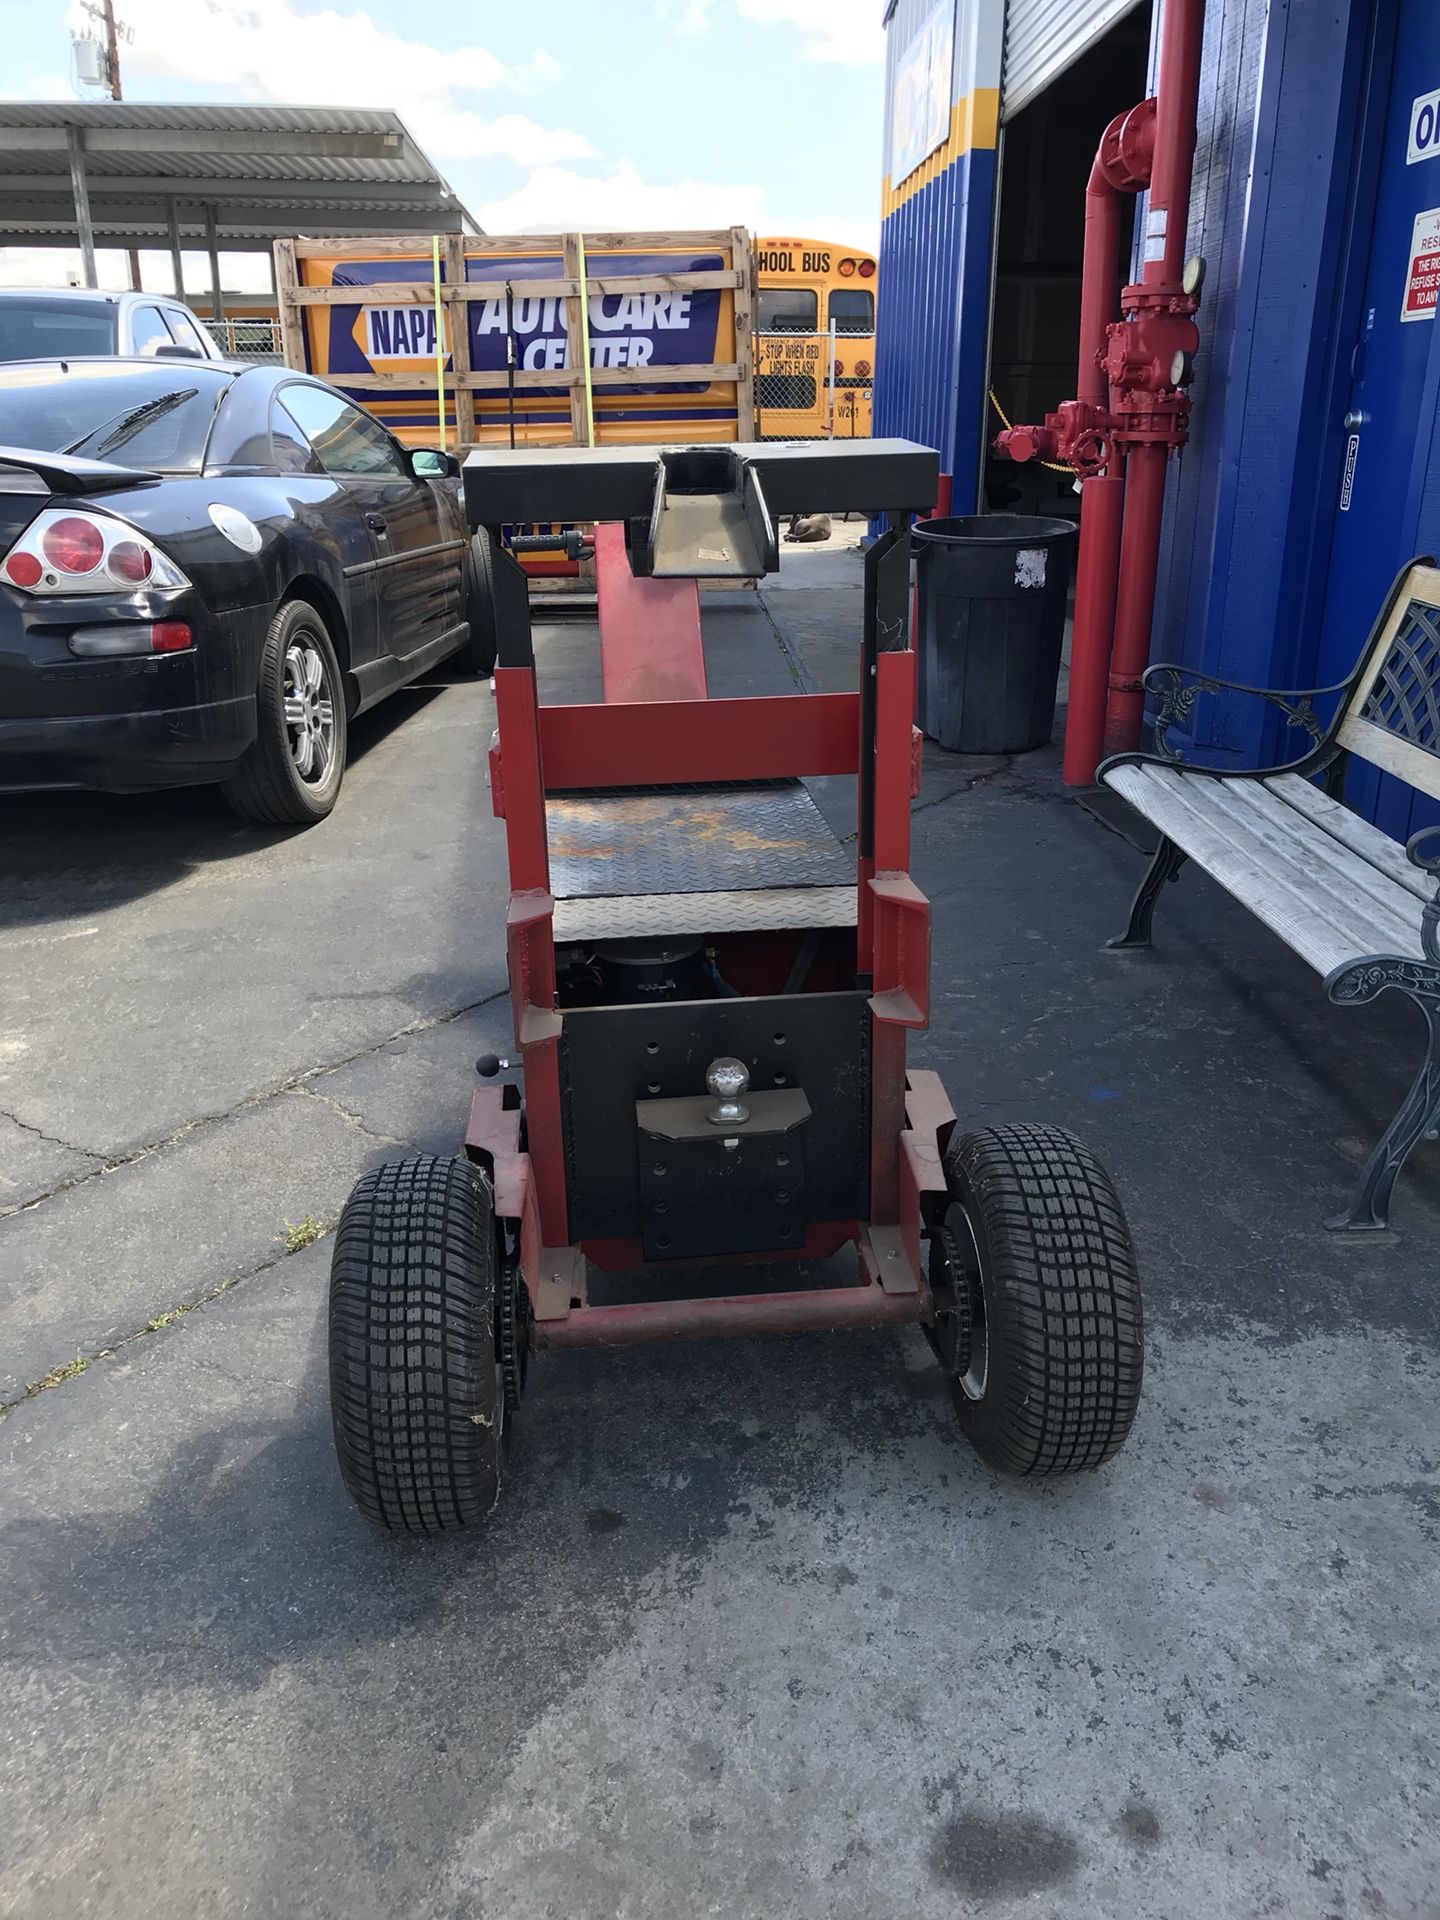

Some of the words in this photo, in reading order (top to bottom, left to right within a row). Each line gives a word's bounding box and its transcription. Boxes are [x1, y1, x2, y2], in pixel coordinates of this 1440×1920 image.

[802, 251, 831, 273] BUS
[1418, 259, 1431, 273] THE
[1410, 273, 1436, 290] REFUSE
[1416, 292, 1425, 305] TO
[1425, 290, 1439, 303] ANY
[370, 309, 445, 355] NAPA
[523, 336, 654, 370] CETER
[766, 344, 784, 360] STOP
[786, 344, 804, 360] WHEN
[806, 344, 819, 360] RED
[769, 360, 793, 375] LIGHTS
[794, 360, 815, 375] FLASH
[1343, 440, 1357, 505] PUSH
